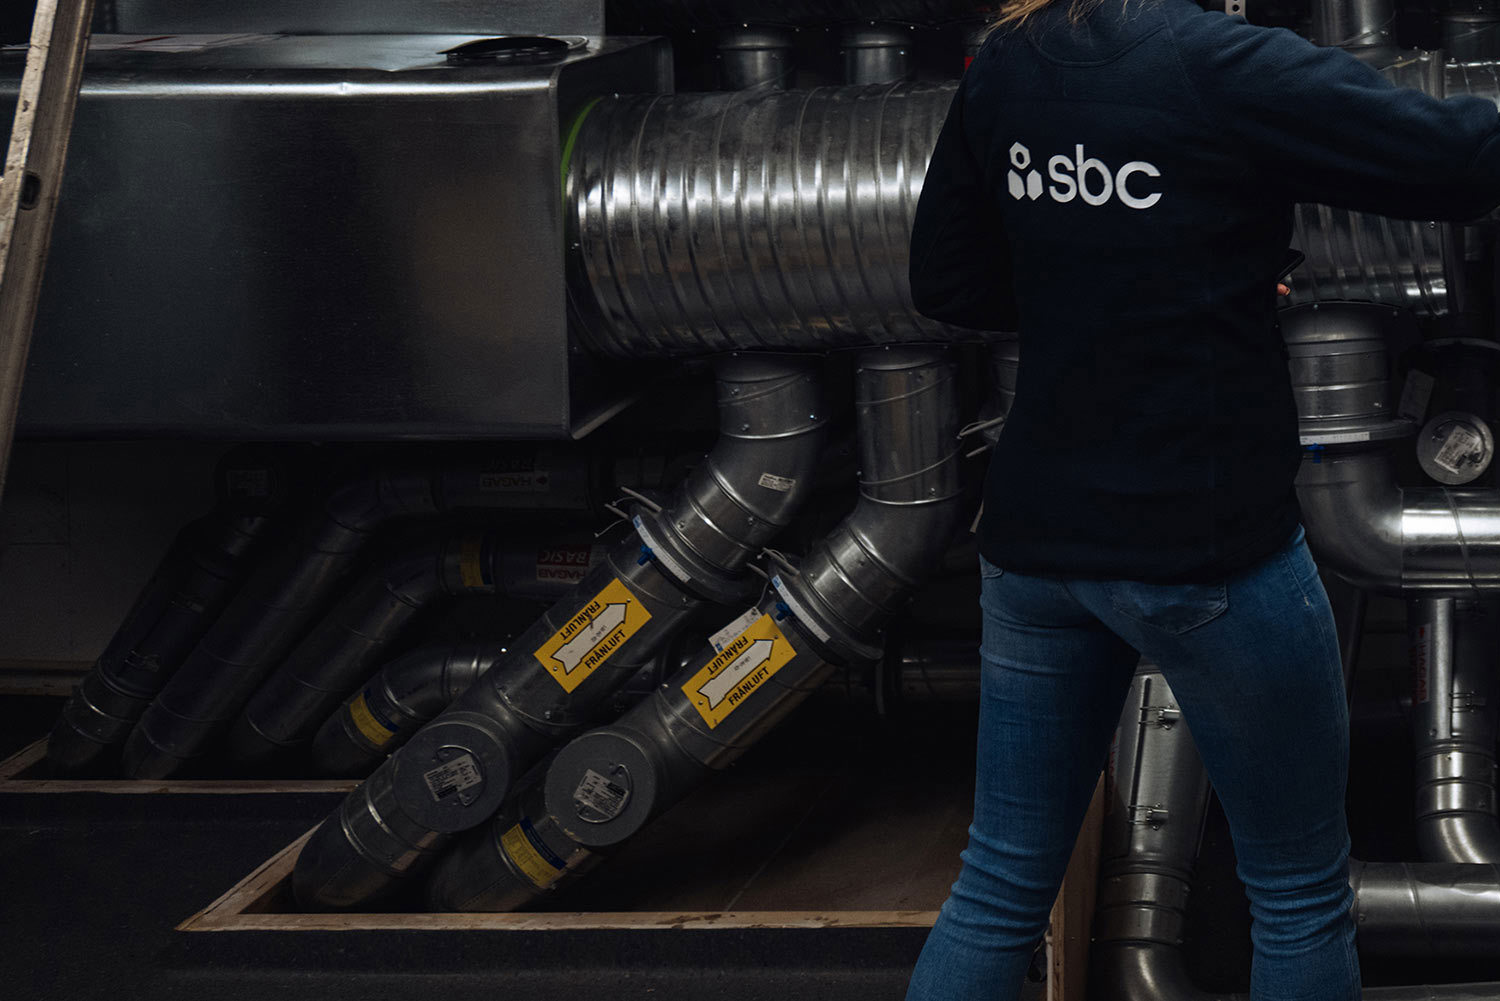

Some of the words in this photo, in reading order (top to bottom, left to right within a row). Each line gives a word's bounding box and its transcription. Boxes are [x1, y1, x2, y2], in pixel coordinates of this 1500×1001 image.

[1047, 143, 1163, 210] sbc
[538, 568, 586, 579] HAGAB
[539, 551, 587, 563] BASIC
[560, 601, 601, 641] FRÅNLUFT
[584, 629, 627, 670] FRÅNLUFT
[707, 636, 749, 676] FRÅNLUFT
[728, 666, 770, 706] FRÅNLUFT
